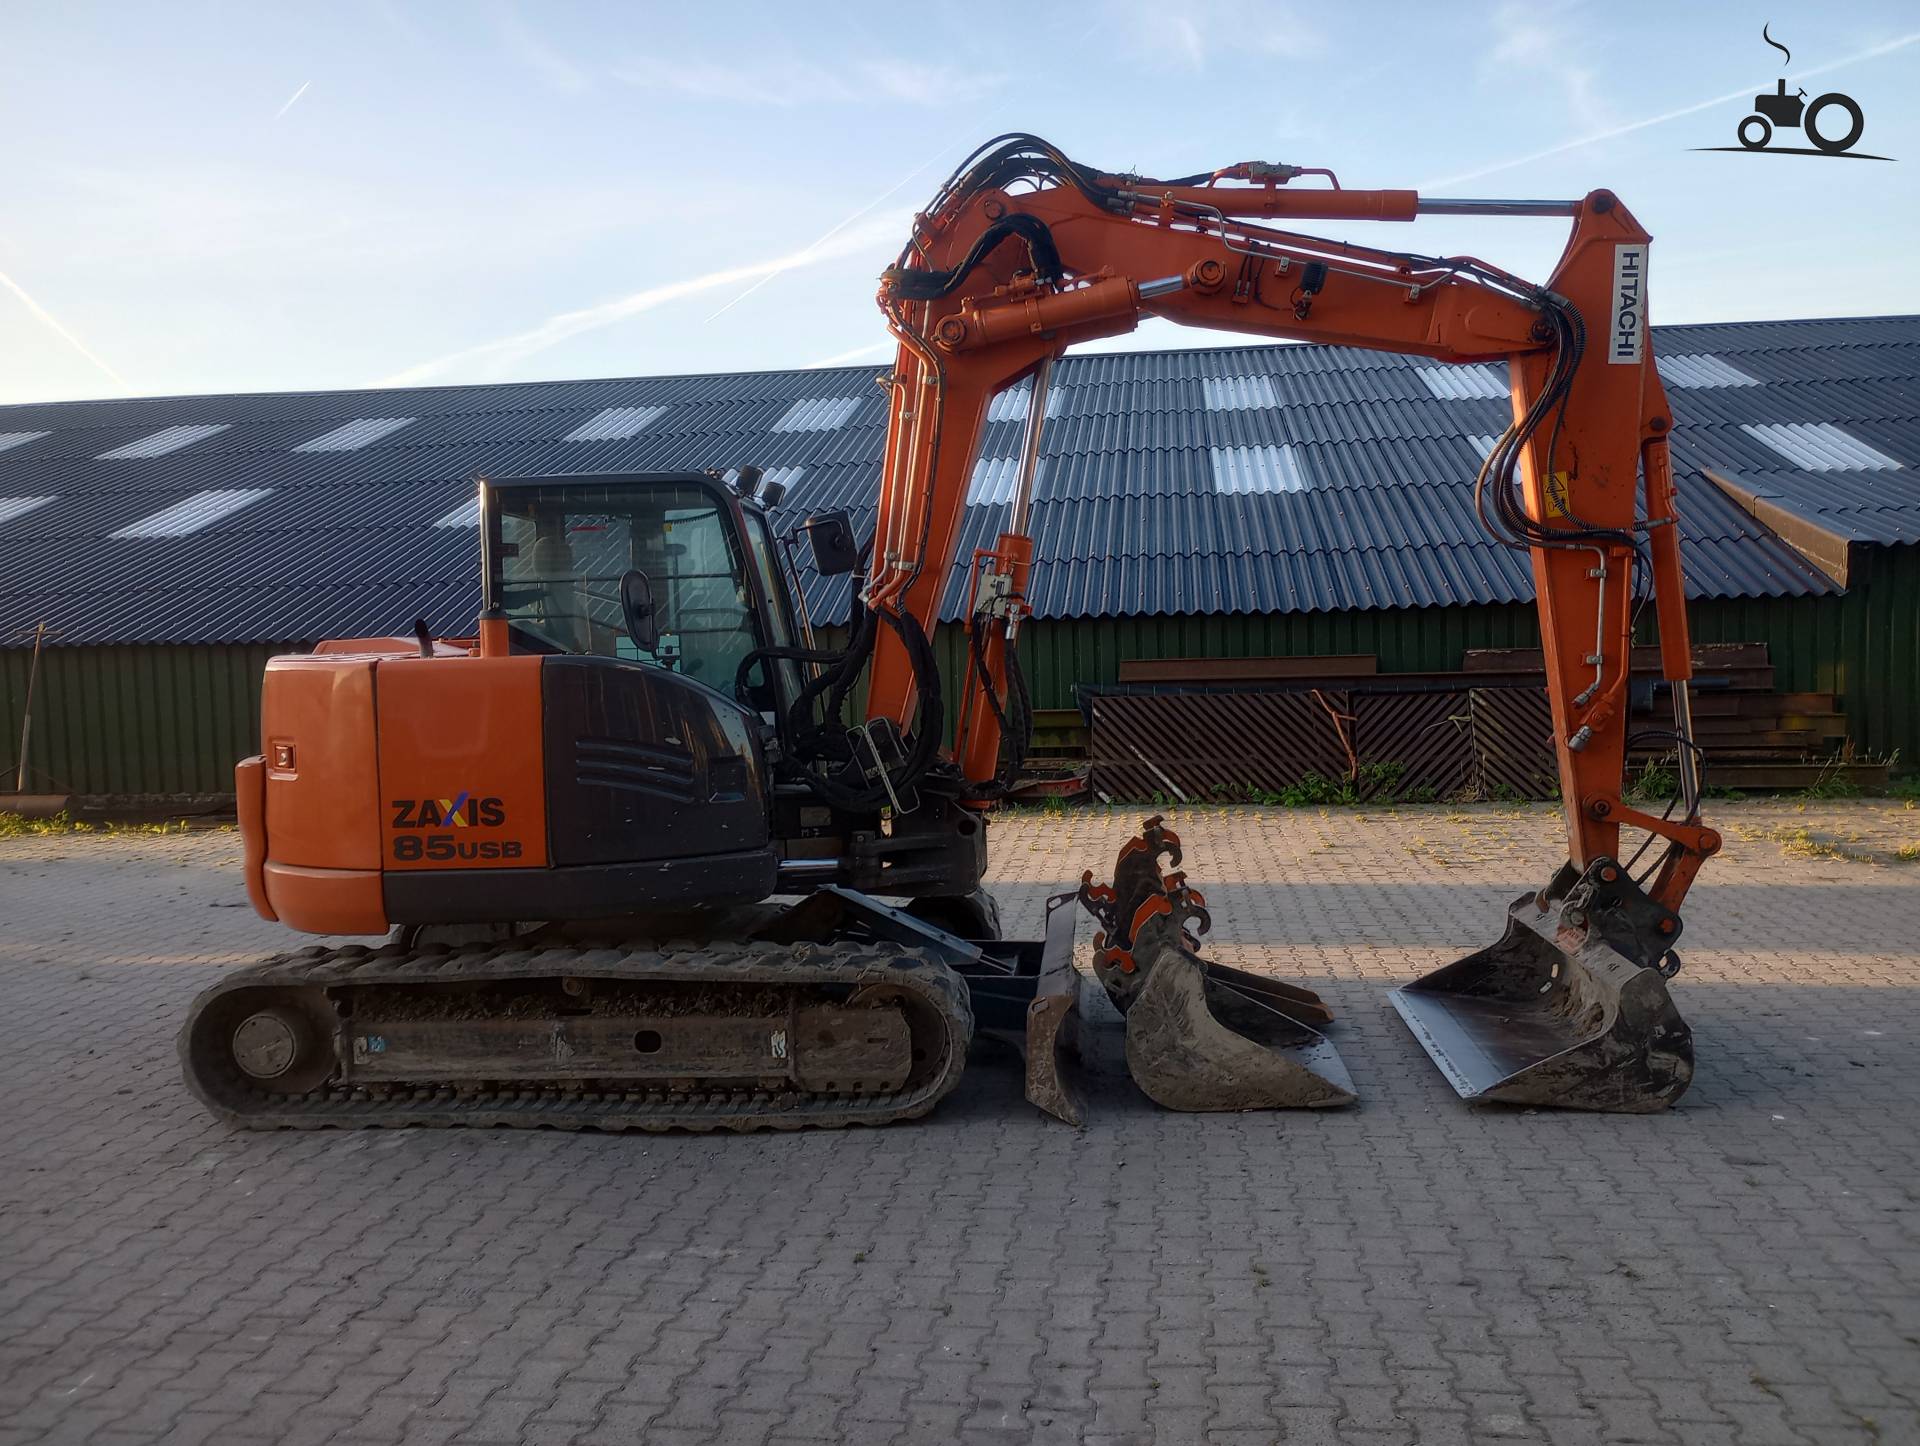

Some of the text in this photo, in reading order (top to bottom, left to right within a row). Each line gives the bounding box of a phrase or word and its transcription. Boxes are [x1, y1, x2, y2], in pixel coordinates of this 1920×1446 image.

[1617, 252, 1640, 357] HITACHI
[392, 791, 505, 828] ZAXIS
[393, 835, 522, 861] 85USB
